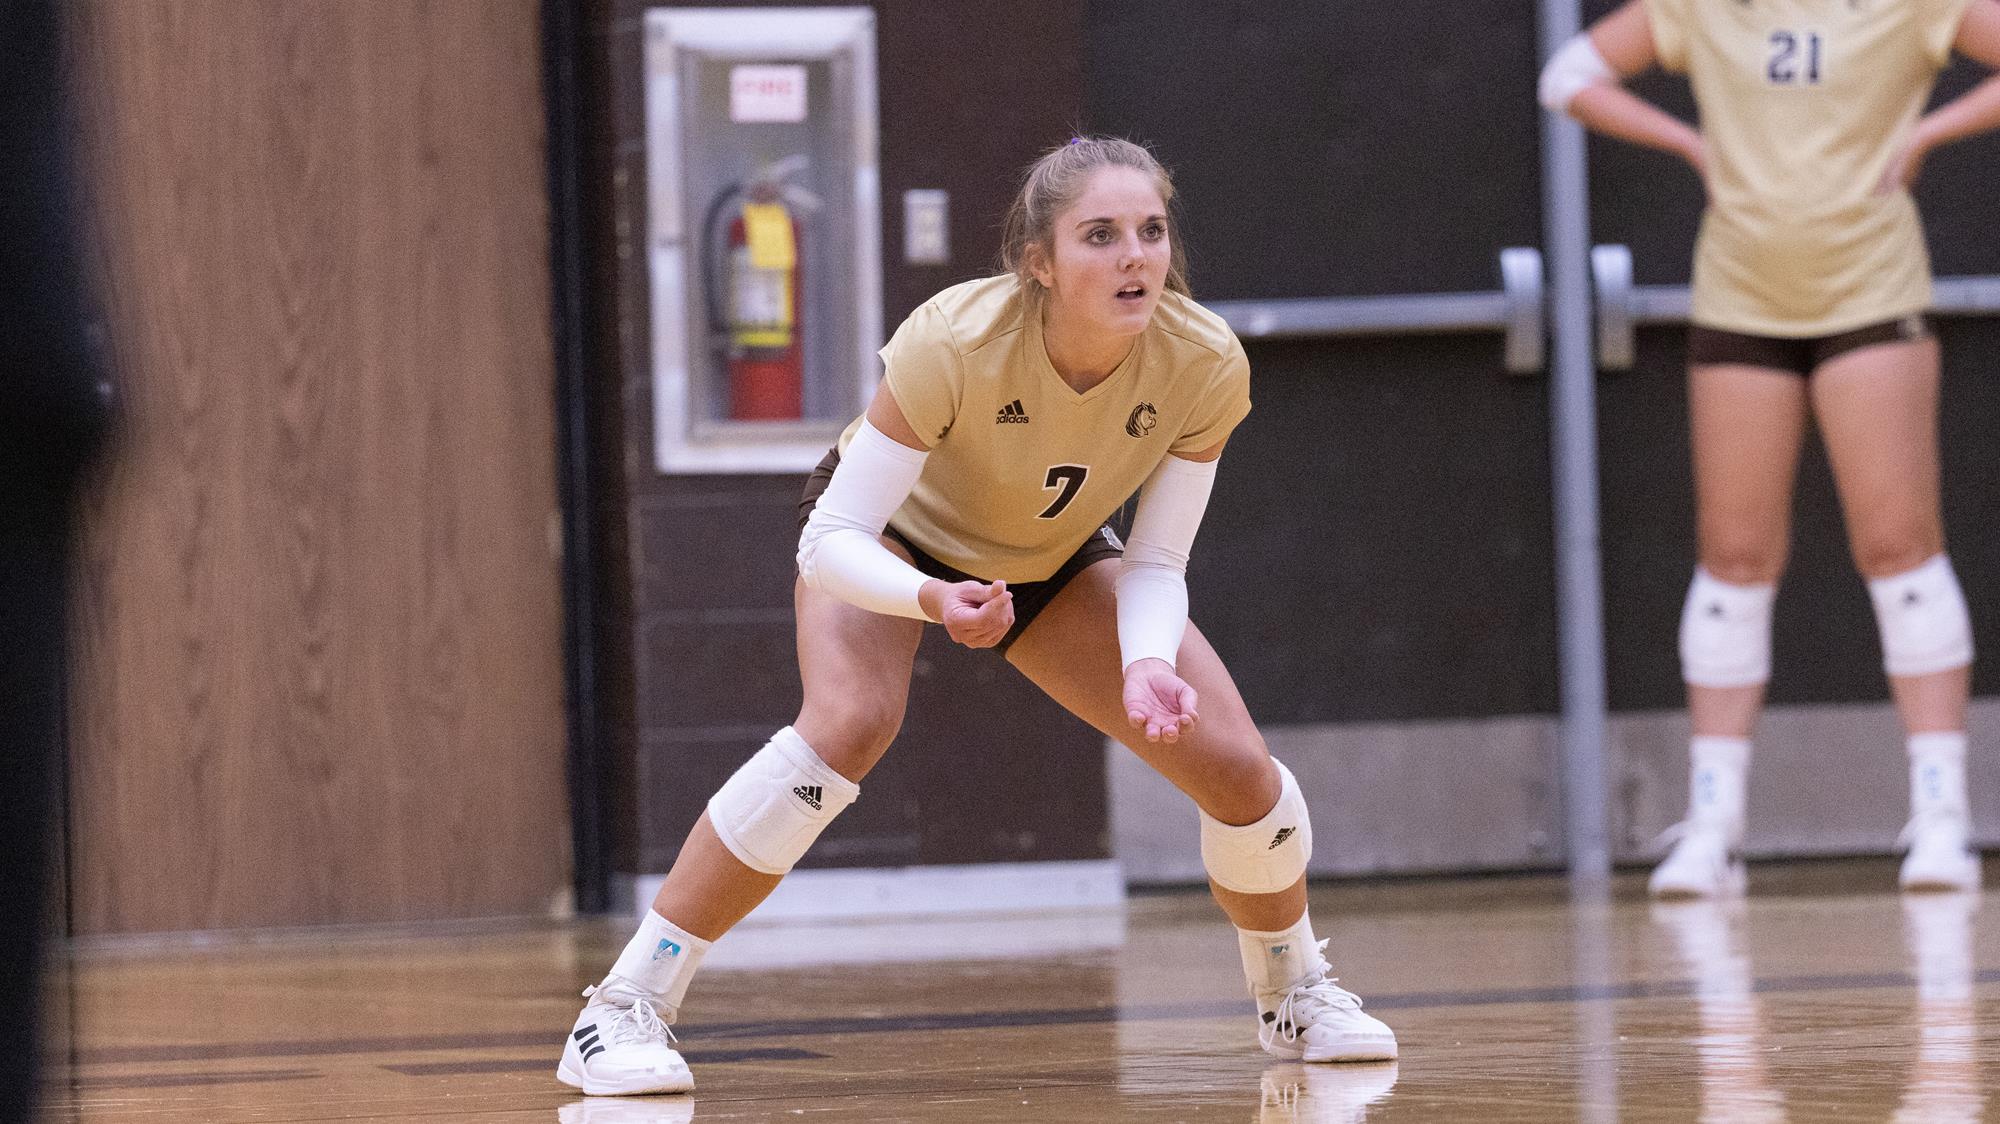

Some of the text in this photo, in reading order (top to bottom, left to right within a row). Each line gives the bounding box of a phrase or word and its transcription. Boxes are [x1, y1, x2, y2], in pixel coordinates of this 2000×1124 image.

[1767, 30, 1819, 83] 21
[1035, 463, 1090, 520] 7
[793, 787, 823, 811] adidas
[1268, 826, 1296, 850] adidas
